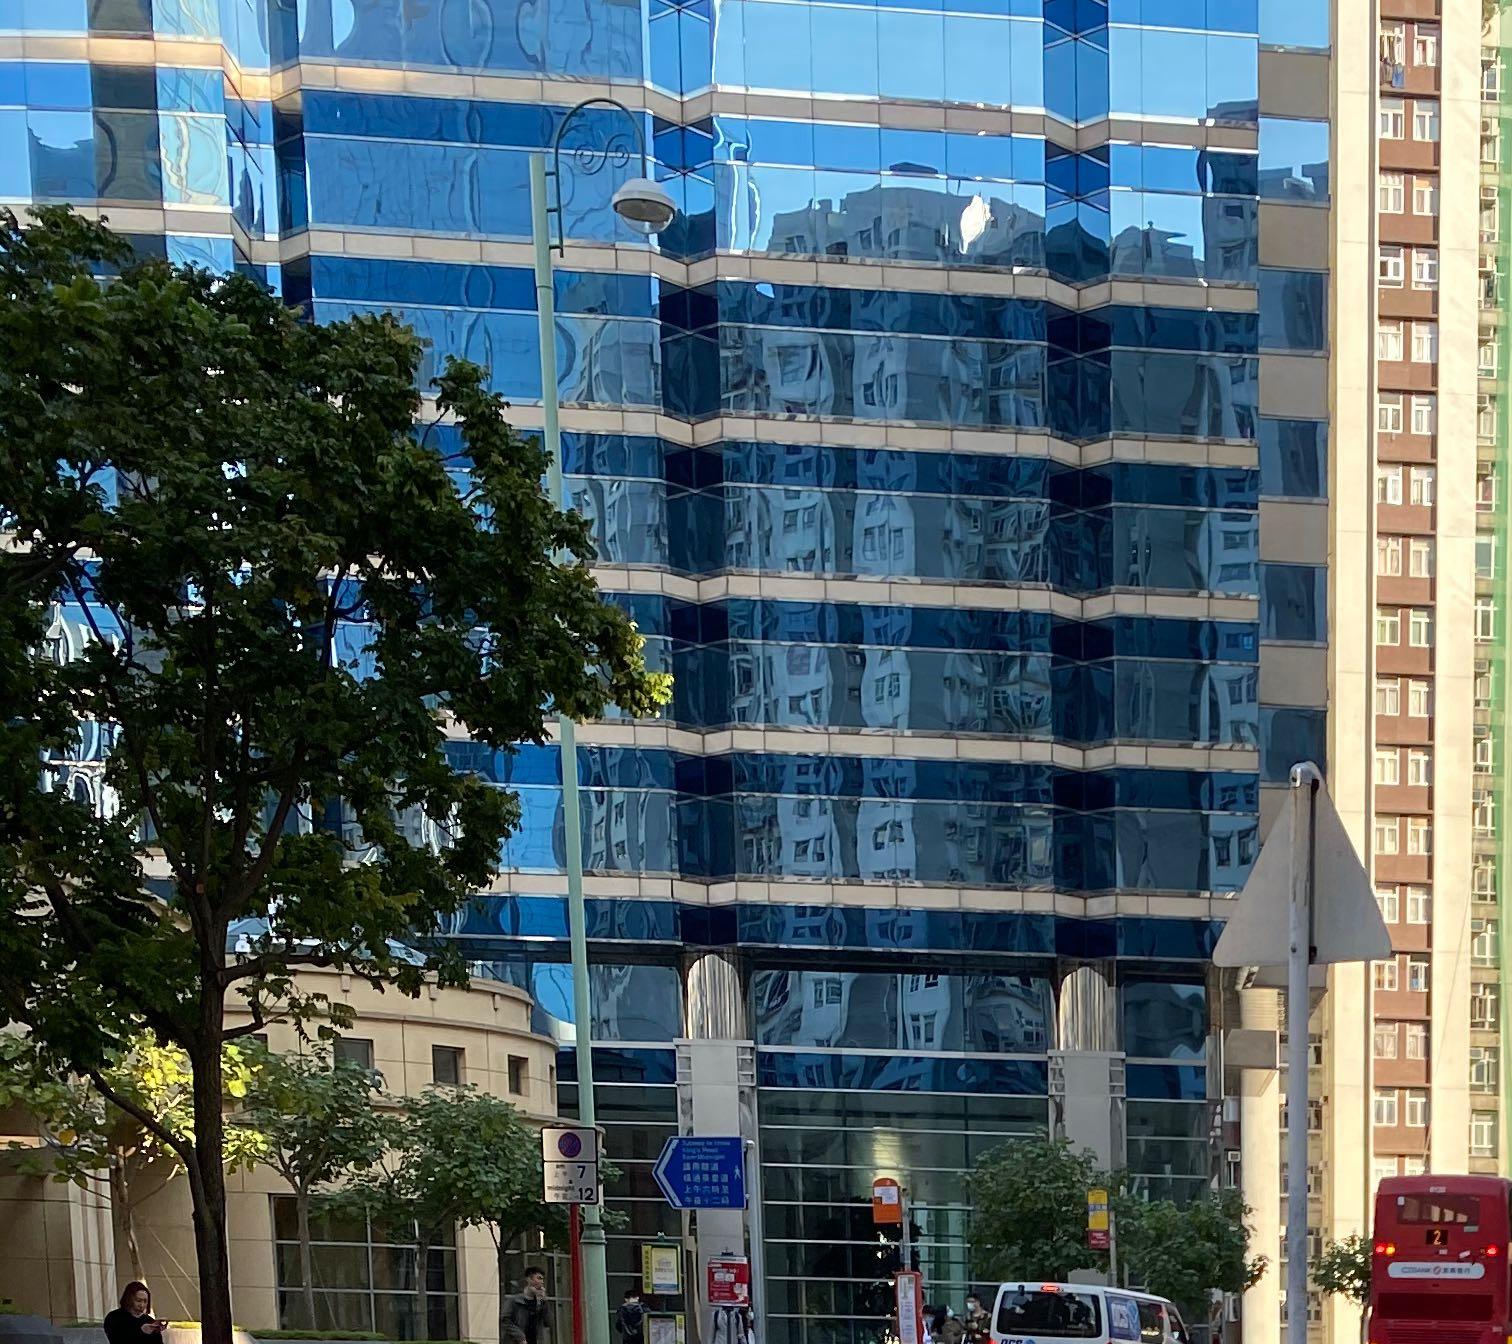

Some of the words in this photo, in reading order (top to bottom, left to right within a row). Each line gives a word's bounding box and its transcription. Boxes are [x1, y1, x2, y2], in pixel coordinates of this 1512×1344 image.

[577, 1165, 586, 1179] 7
[578, 1187, 594, 1201] 12
[1433, 1230, 1442, 1245] 2
